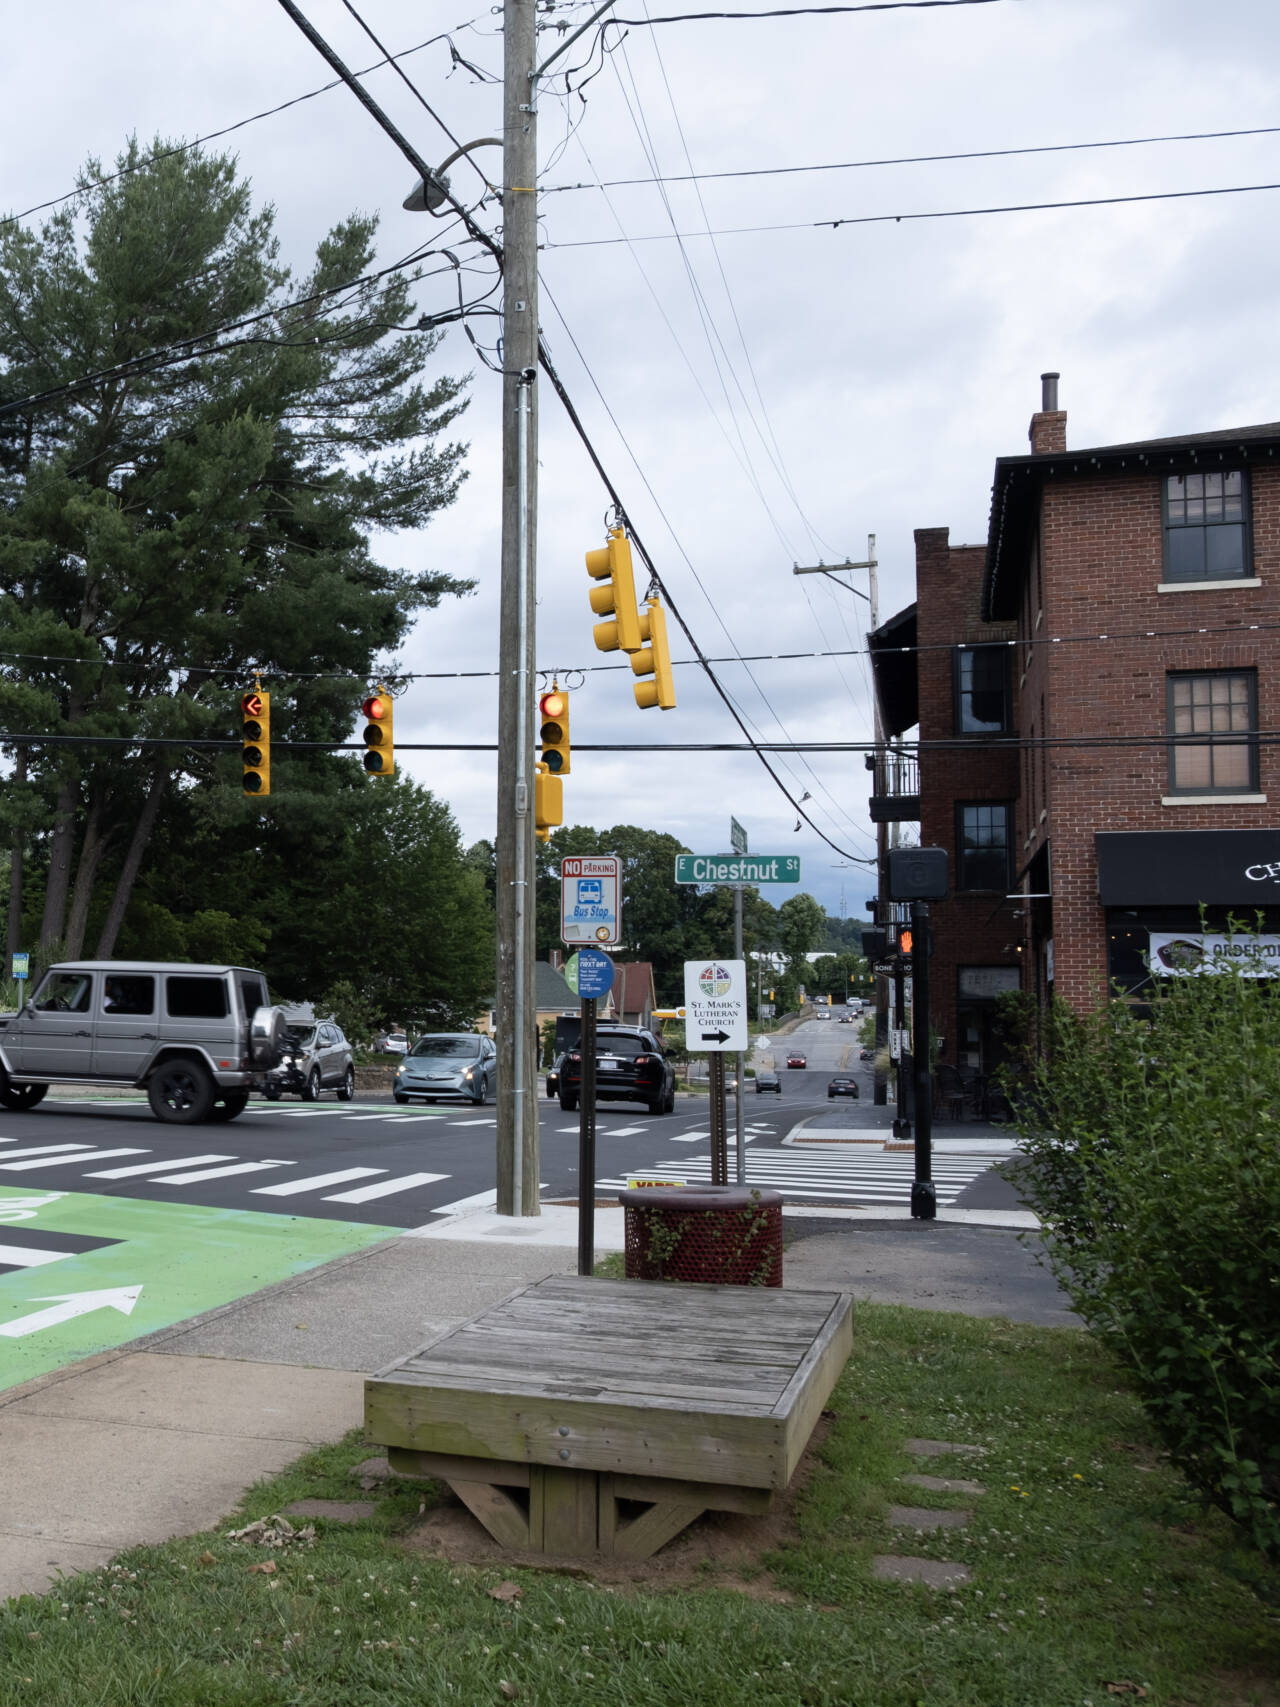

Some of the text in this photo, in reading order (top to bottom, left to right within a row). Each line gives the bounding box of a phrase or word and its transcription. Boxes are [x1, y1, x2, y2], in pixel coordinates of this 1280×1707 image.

[565, 861, 614, 875] NO PARKING
[679, 856, 798, 880] E Chestnut St
[574, 905, 608, 919] Bus Stop
[691, 1000, 741, 1009] ST. MARK'S
[694, 1009, 739, 1018] LUTHERAN
[698, 1017, 735, 1026] CHURCH
